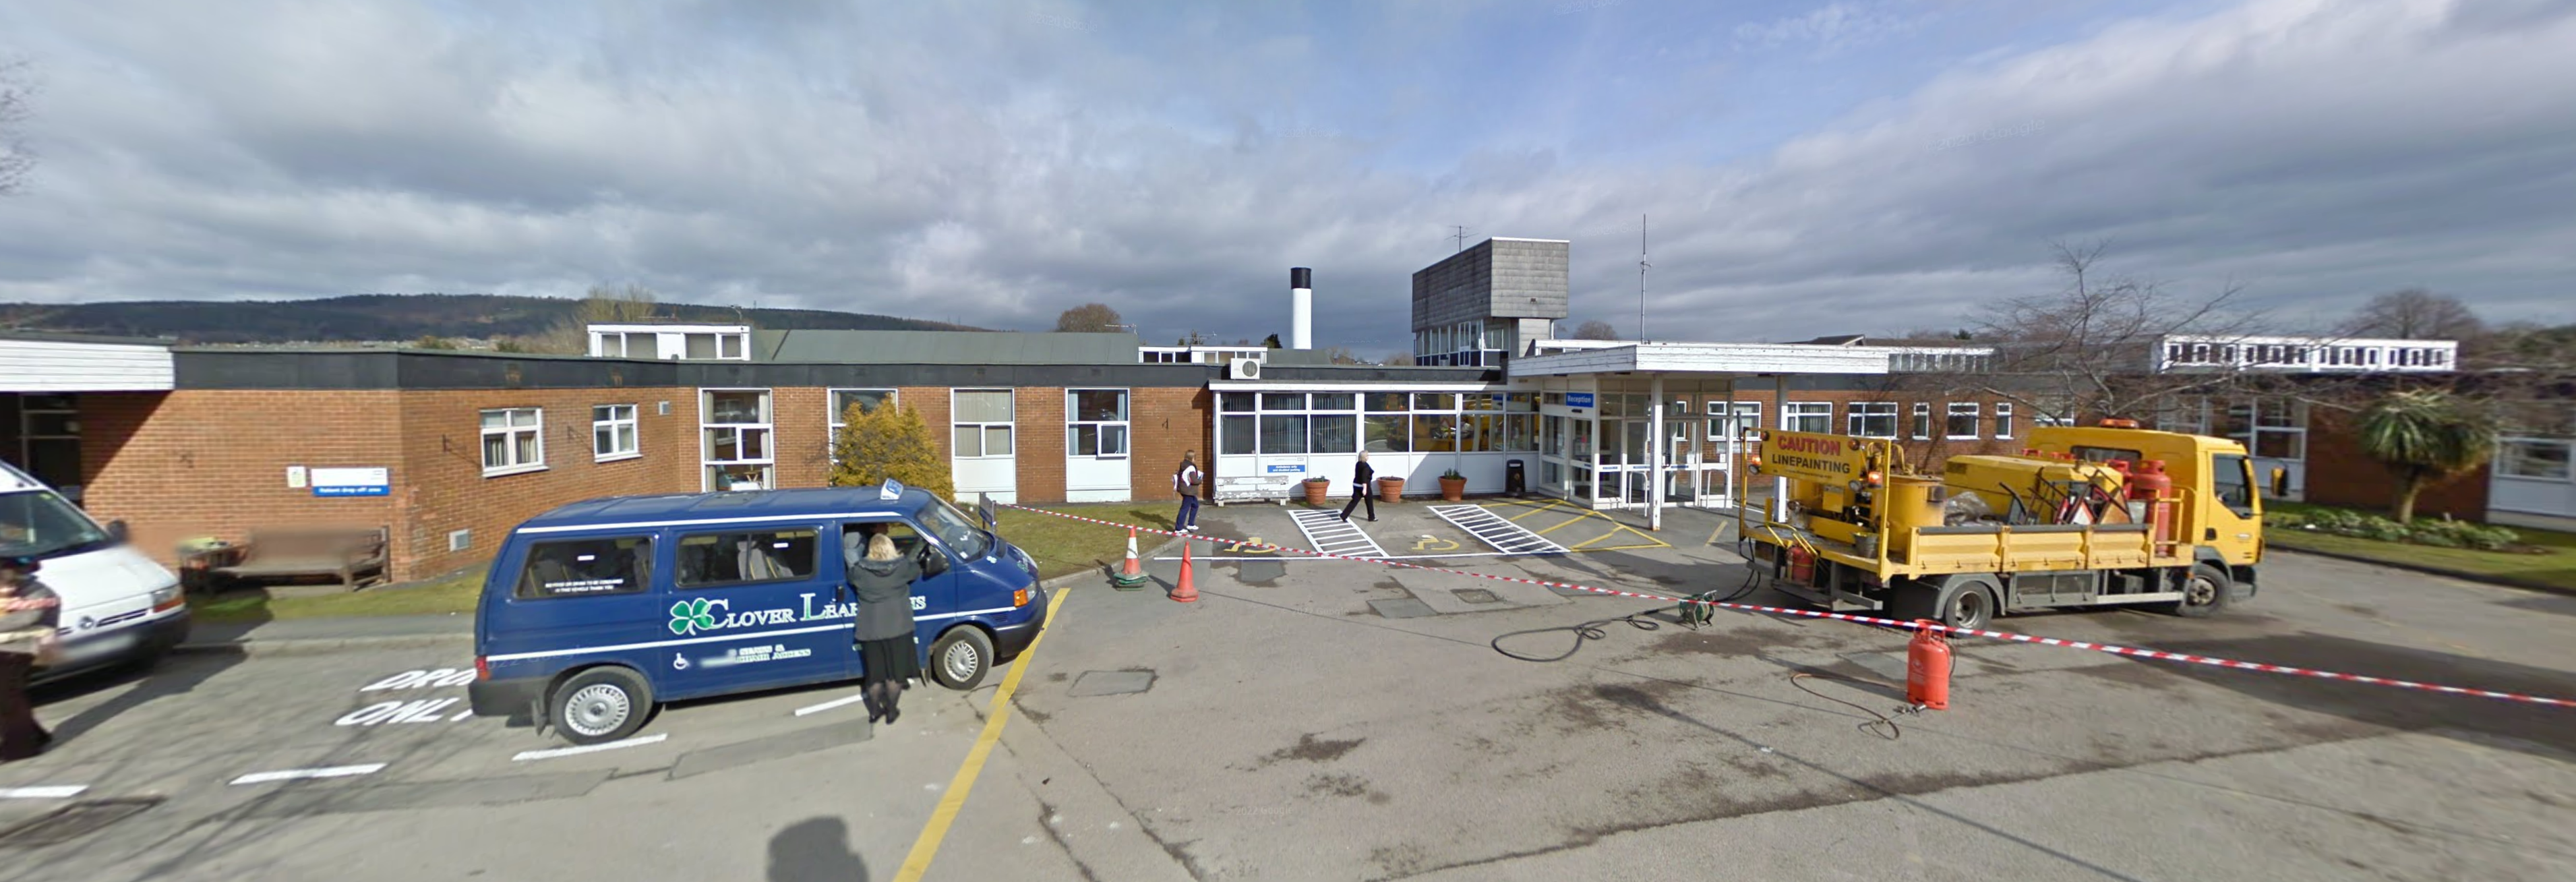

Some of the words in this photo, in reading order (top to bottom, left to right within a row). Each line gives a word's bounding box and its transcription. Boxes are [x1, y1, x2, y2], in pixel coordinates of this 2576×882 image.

[1567, 395, 1592, 404] Reception
[1777, 435, 1840, 456] CAUTION
[1772, 454, 1851, 473] LINEPAINTING
[702, 598, 796, 629] CLOVER
[359, 667, 478, 692] DRO
